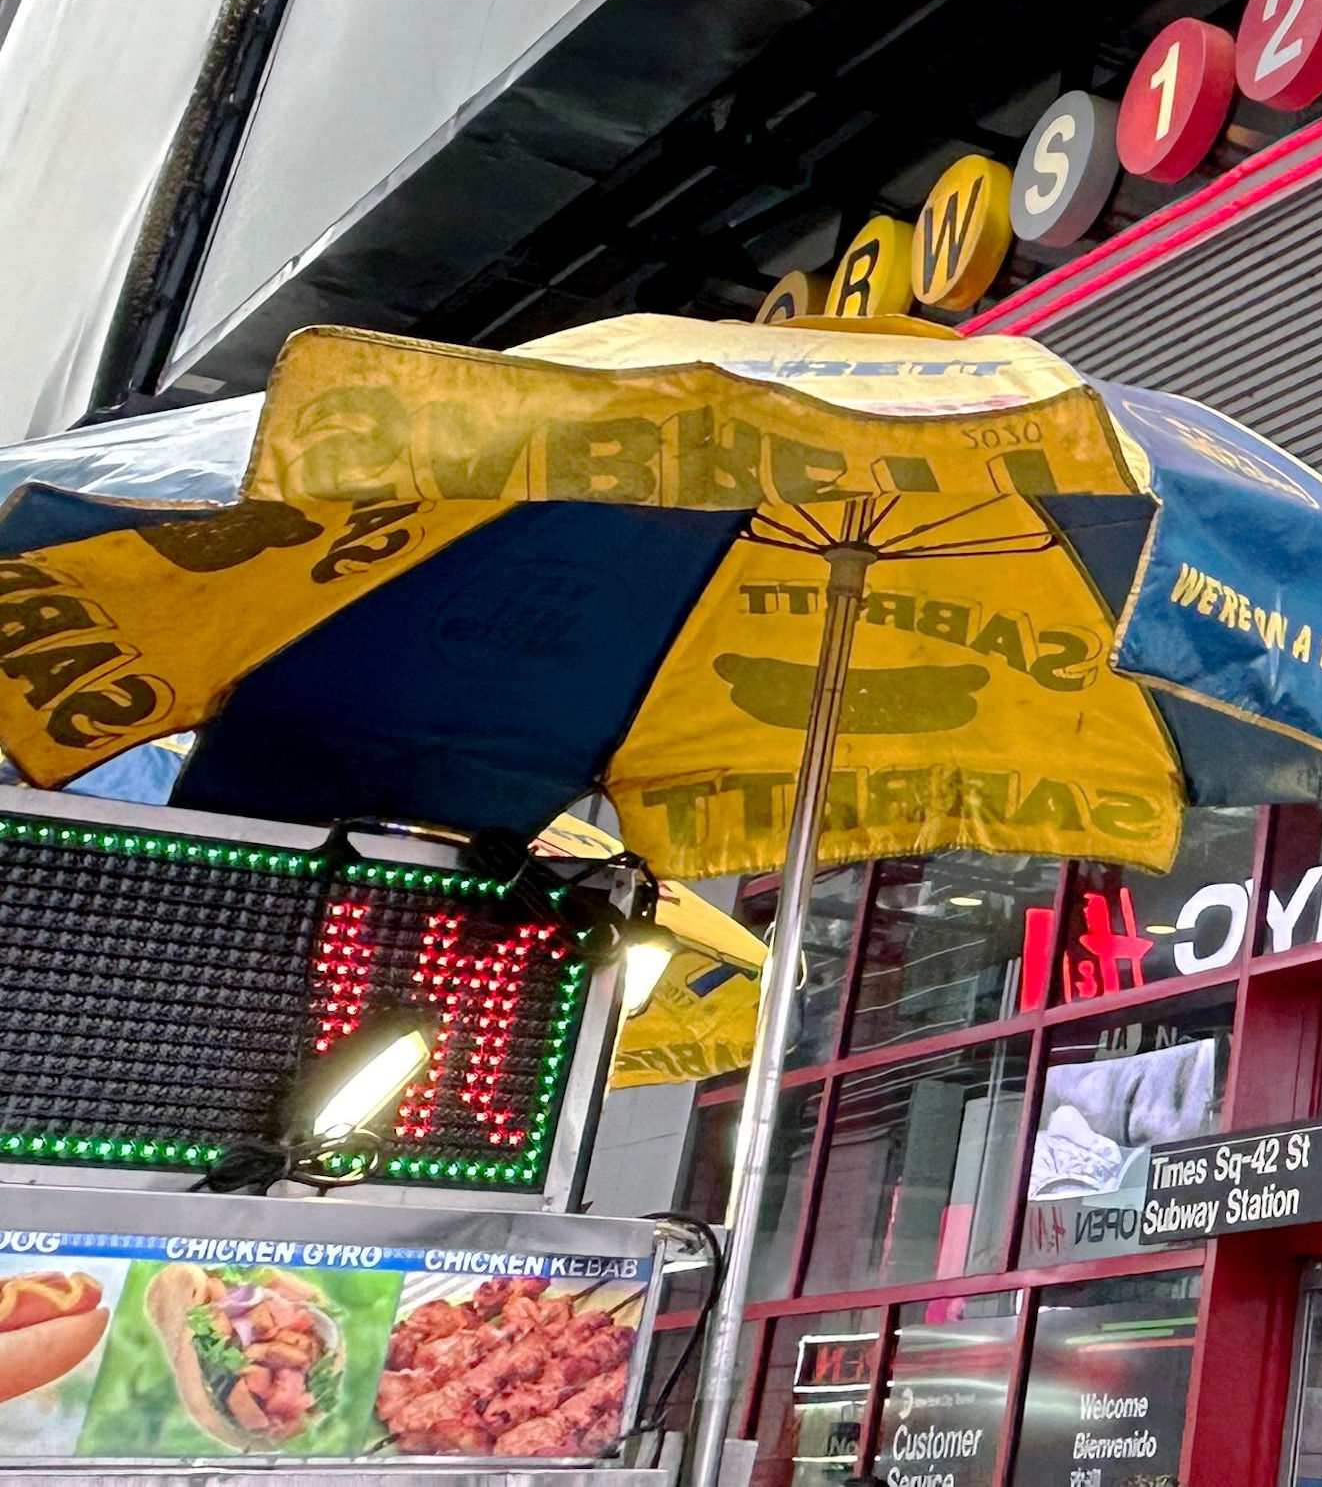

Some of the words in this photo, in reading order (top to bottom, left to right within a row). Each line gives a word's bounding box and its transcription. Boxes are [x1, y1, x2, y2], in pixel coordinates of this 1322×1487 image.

[921, 173, 984, 296] W
[1023, 113, 1077, 216] S
[1292, 624, 1312, 663] A
[1151, 1156, 1208, 1190] Times
[1213, 1137, 1280, 1186] Sq-42
[1285, 1132, 1312, 1172] St
[1142, 1197, 1220, 1235] Subway
[1225, 1183, 1300, 1225] Station
[166, 1236, 296, 1264] CHICKEN
[302, 1244, 383, 1268] GYRO
[424, 1249, 544, 1278] CHICKEN
[548, 1255, 639, 1280] KEBAB
[1079, 1392, 1149, 1420] Welcome
[892, 1424, 984, 1461] Customer
[1072, 1429, 1158, 1460] Bienvenido
